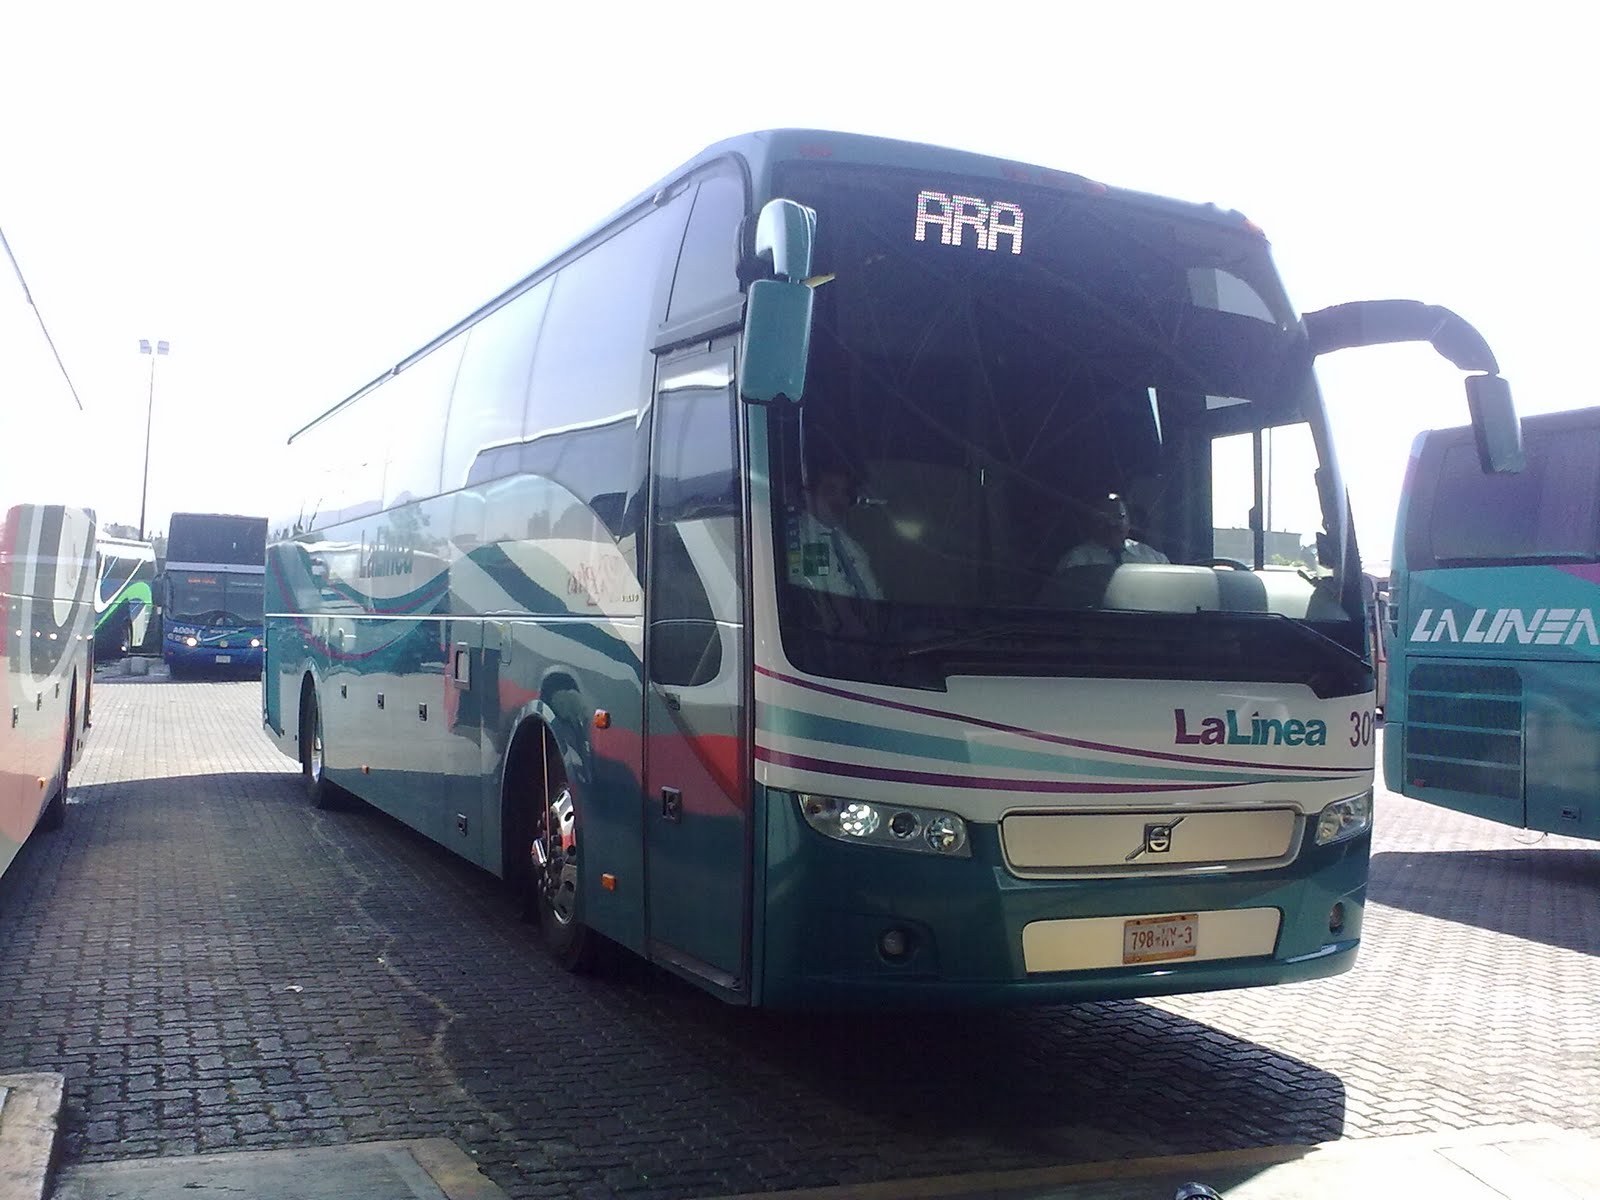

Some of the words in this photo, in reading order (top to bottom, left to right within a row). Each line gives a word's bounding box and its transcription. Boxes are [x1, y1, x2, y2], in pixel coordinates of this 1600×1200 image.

[914, 190, 1024, 255] ARA
[1410, 608, 1459, 643] LA
[1462, 608, 1600, 646] LINEA
